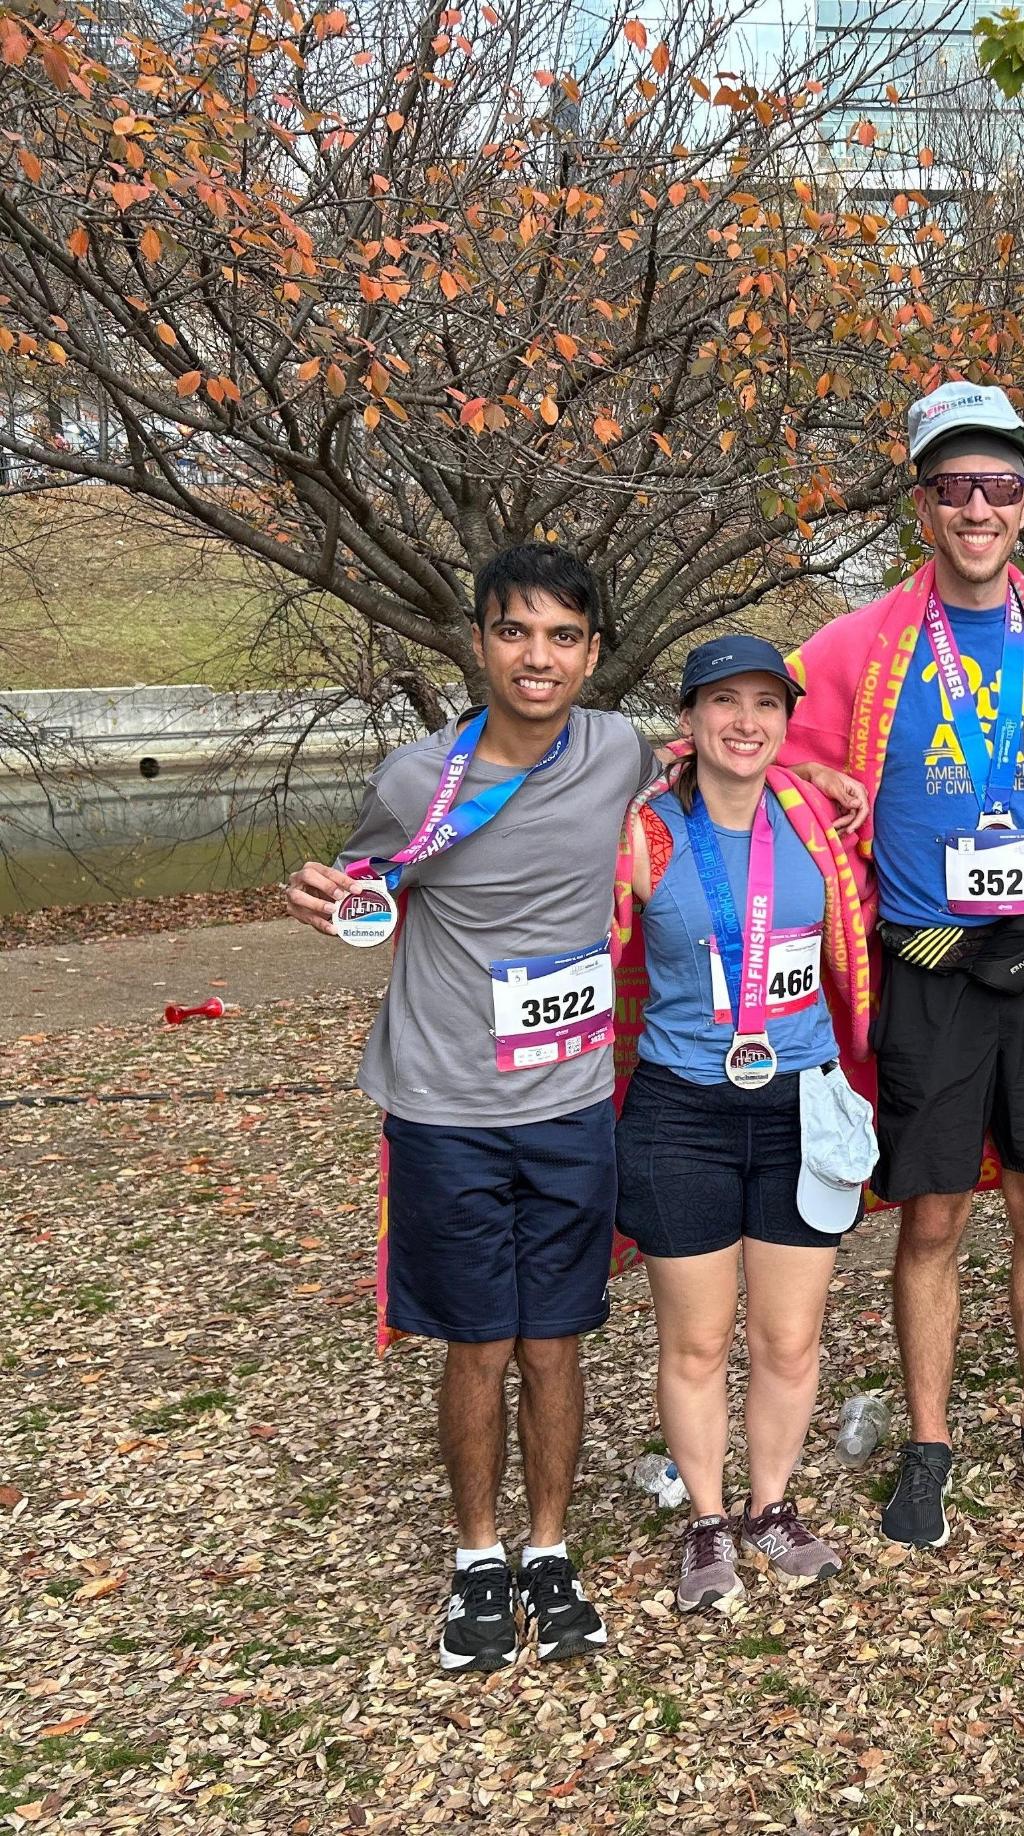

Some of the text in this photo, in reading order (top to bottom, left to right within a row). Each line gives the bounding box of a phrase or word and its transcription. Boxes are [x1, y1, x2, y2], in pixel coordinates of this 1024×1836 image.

[926, 395, 983, 418] FINISHER
[930, 621, 965, 700] FINISHER
[855, 660, 882, 772] MARATHON
[426, 753, 468, 832] FINISHER
[926, 766, 971, 780] AMERI
[926, 781, 941, 795] OF
[715, 881, 738, 934] RICHMOND
[343, 929, 385, 937] Richmond
[745, 895, 768, 1008] 13.1 FINISHER
[521, 986, 595, 1028] 3522
